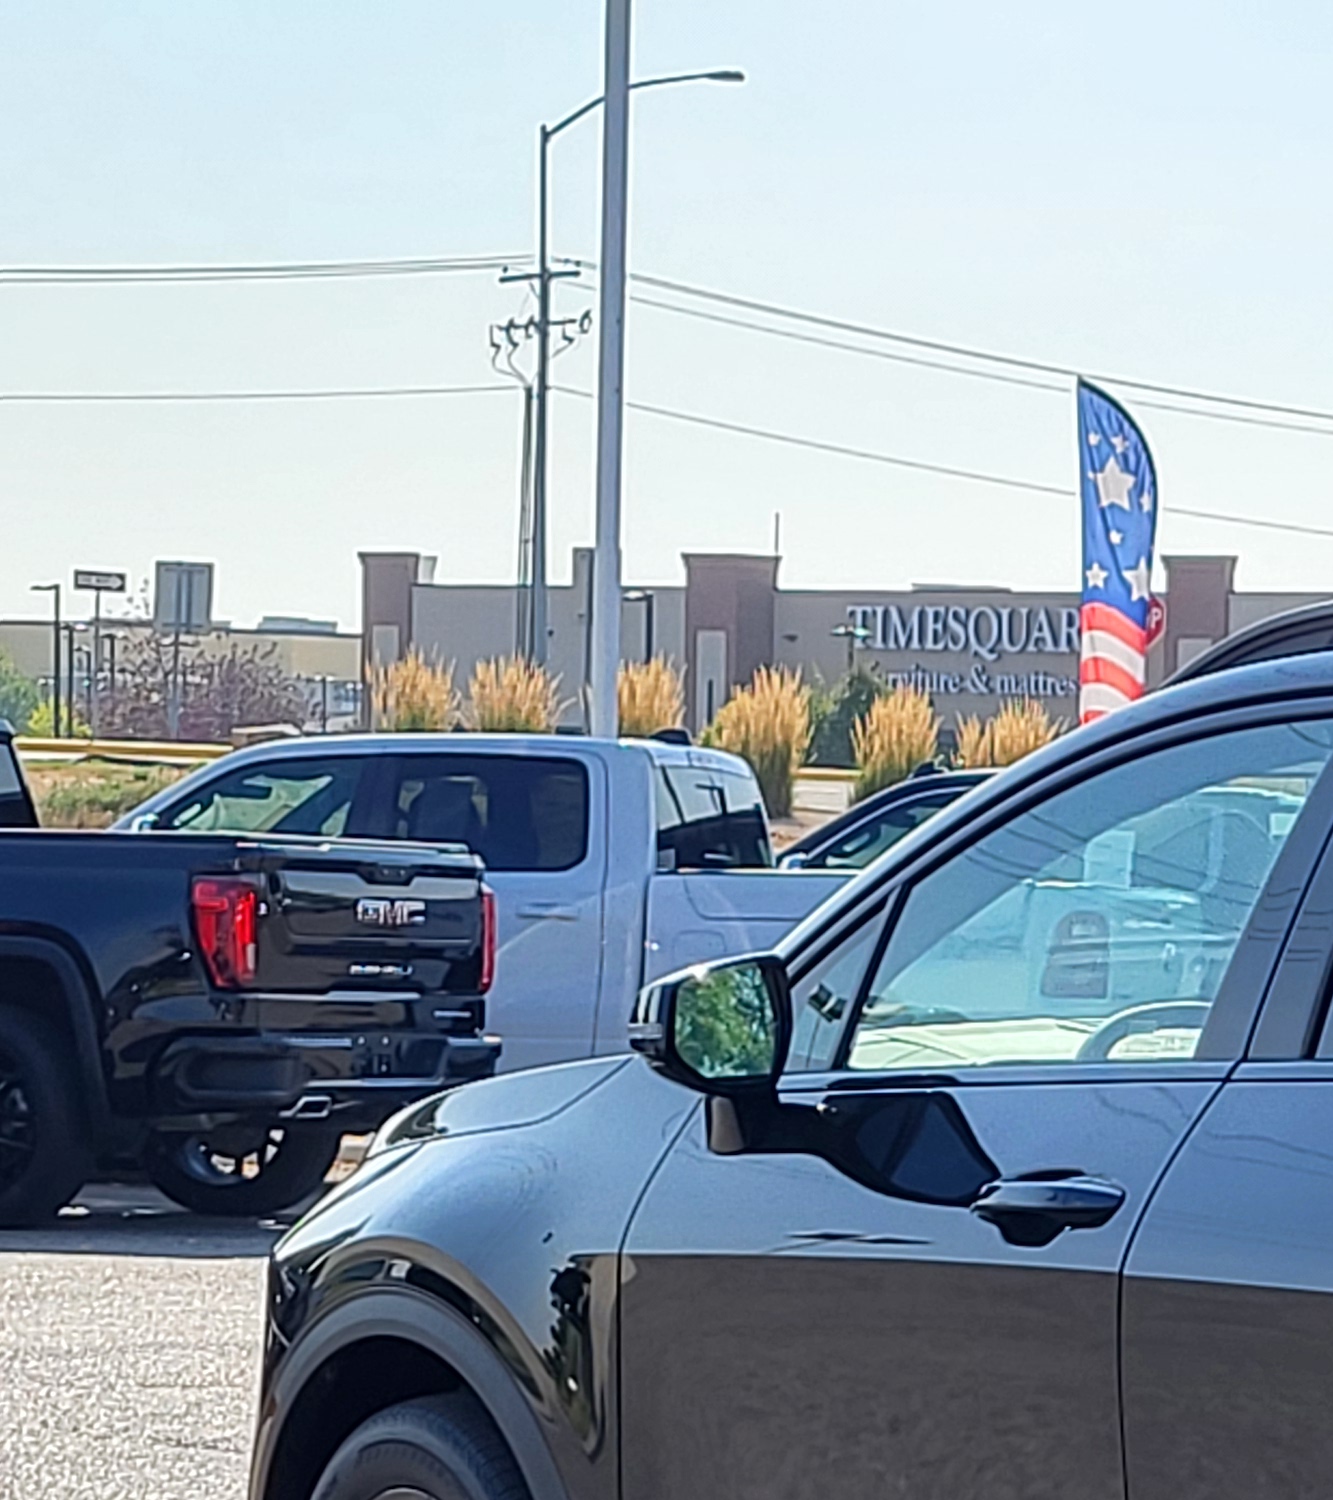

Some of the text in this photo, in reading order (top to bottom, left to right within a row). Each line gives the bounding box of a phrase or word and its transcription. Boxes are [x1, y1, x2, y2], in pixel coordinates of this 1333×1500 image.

[846, 606, 1081, 660] TIMESQUAR
[969, 664, 990, 694] &
[995, 671, 1077, 696] mattres
[356, 898, 426, 925] GMC
